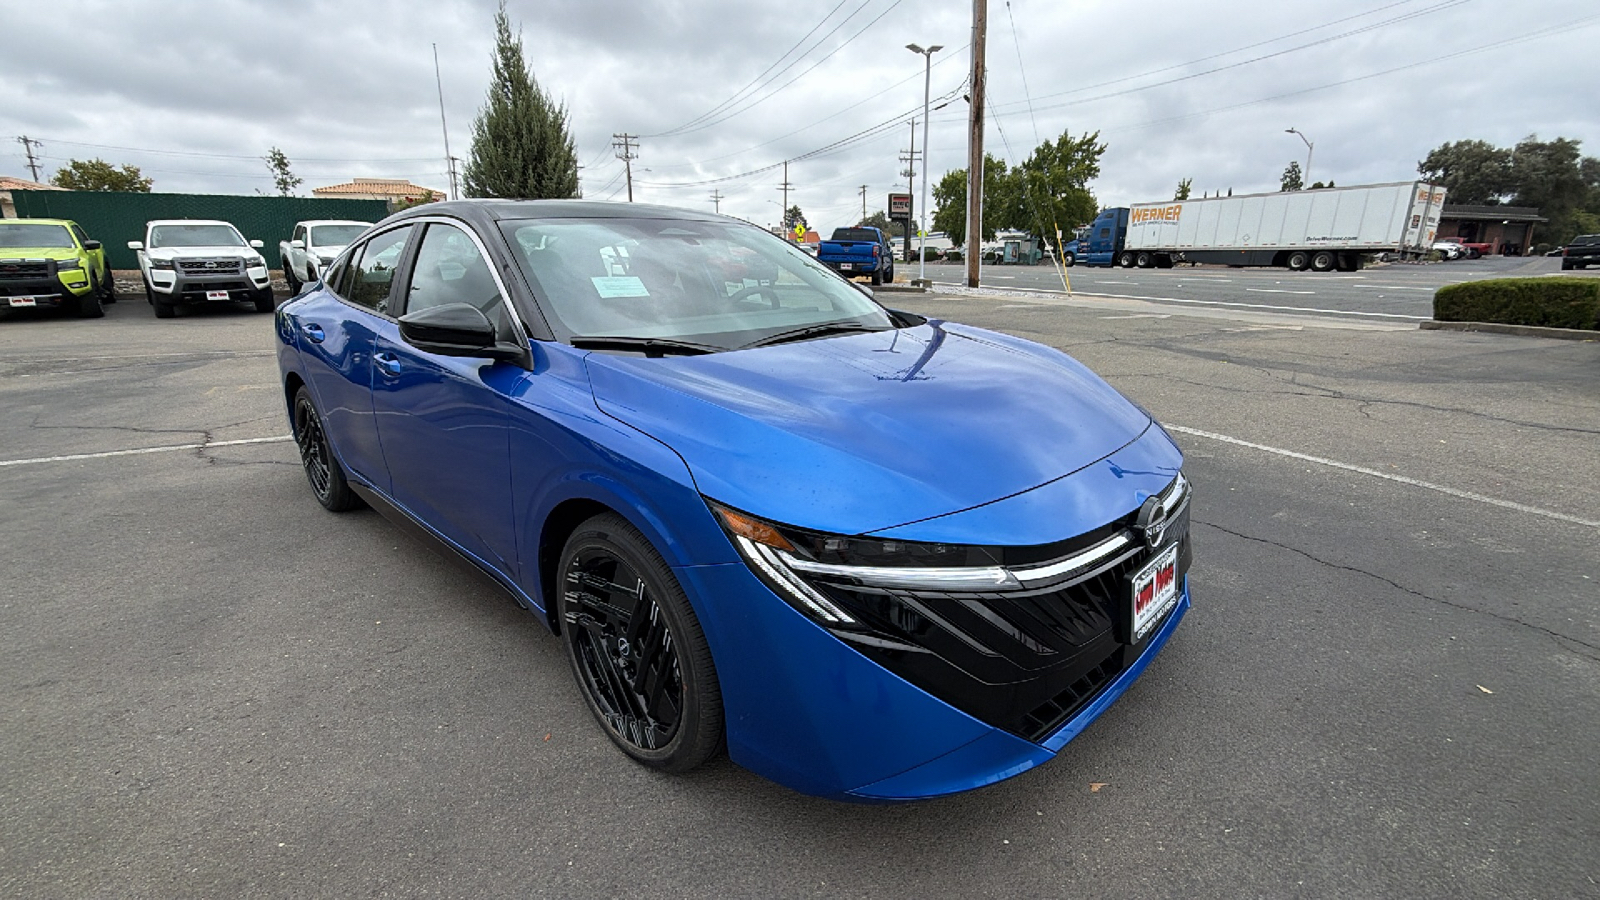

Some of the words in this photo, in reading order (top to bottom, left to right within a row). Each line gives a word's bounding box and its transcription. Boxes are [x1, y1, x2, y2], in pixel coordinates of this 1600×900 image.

[1132, 205, 1181, 223] WERNER
[1137, 614, 1157, 639] CROWN
[1157, 596, 1175, 620] MOTORS
